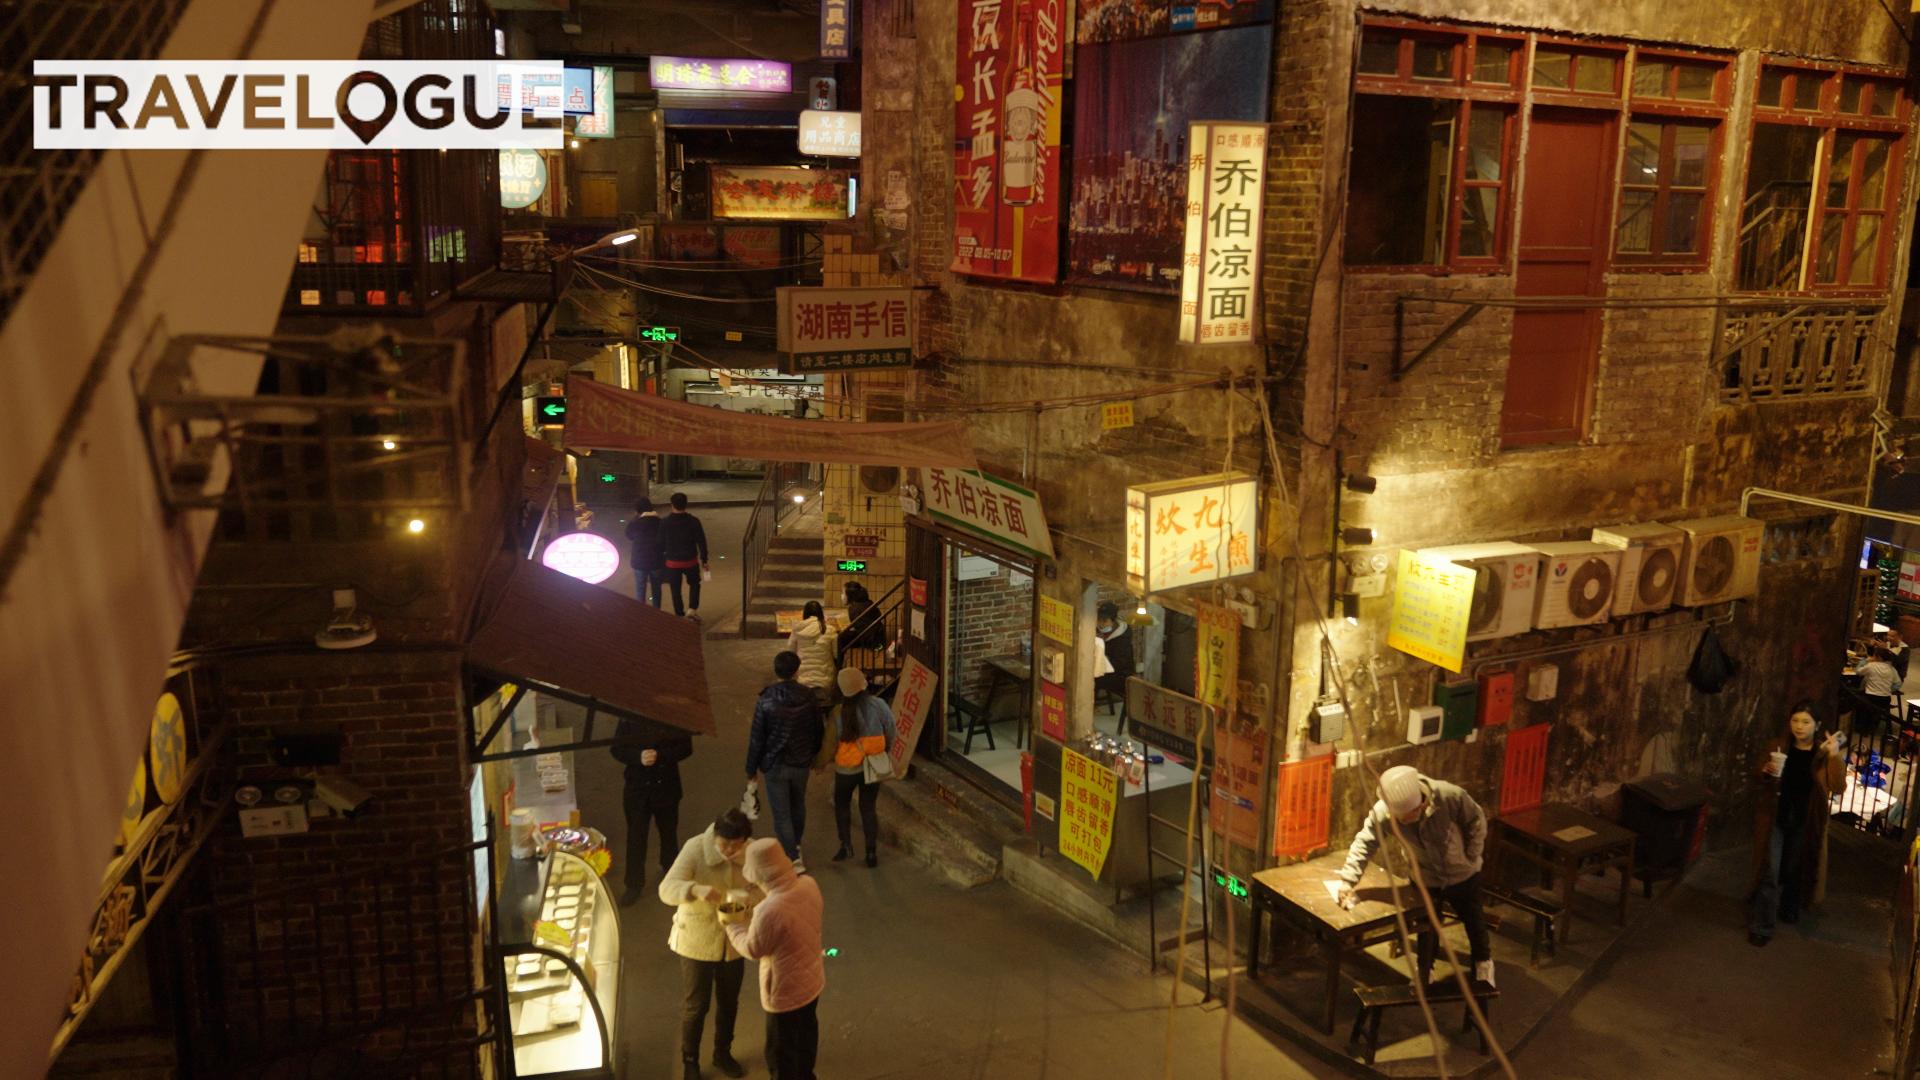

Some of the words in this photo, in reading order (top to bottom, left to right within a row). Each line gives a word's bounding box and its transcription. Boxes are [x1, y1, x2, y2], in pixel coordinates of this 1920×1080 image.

[1184, 154, 1205, 316] 乔伯凉面
[1208, 159, 1257, 320] 乔伯凉面
[796, 300, 908, 340] 湖南手信
[931, 468, 1028, 538] 乔伯凉面
[892, 664, 928, 762] 乔伯凉面
[1066, 751, 1086, 780] 凉面
[1090, 765, 1113, 793] 11元
[1071, 822, 1102, 854] 可打包
